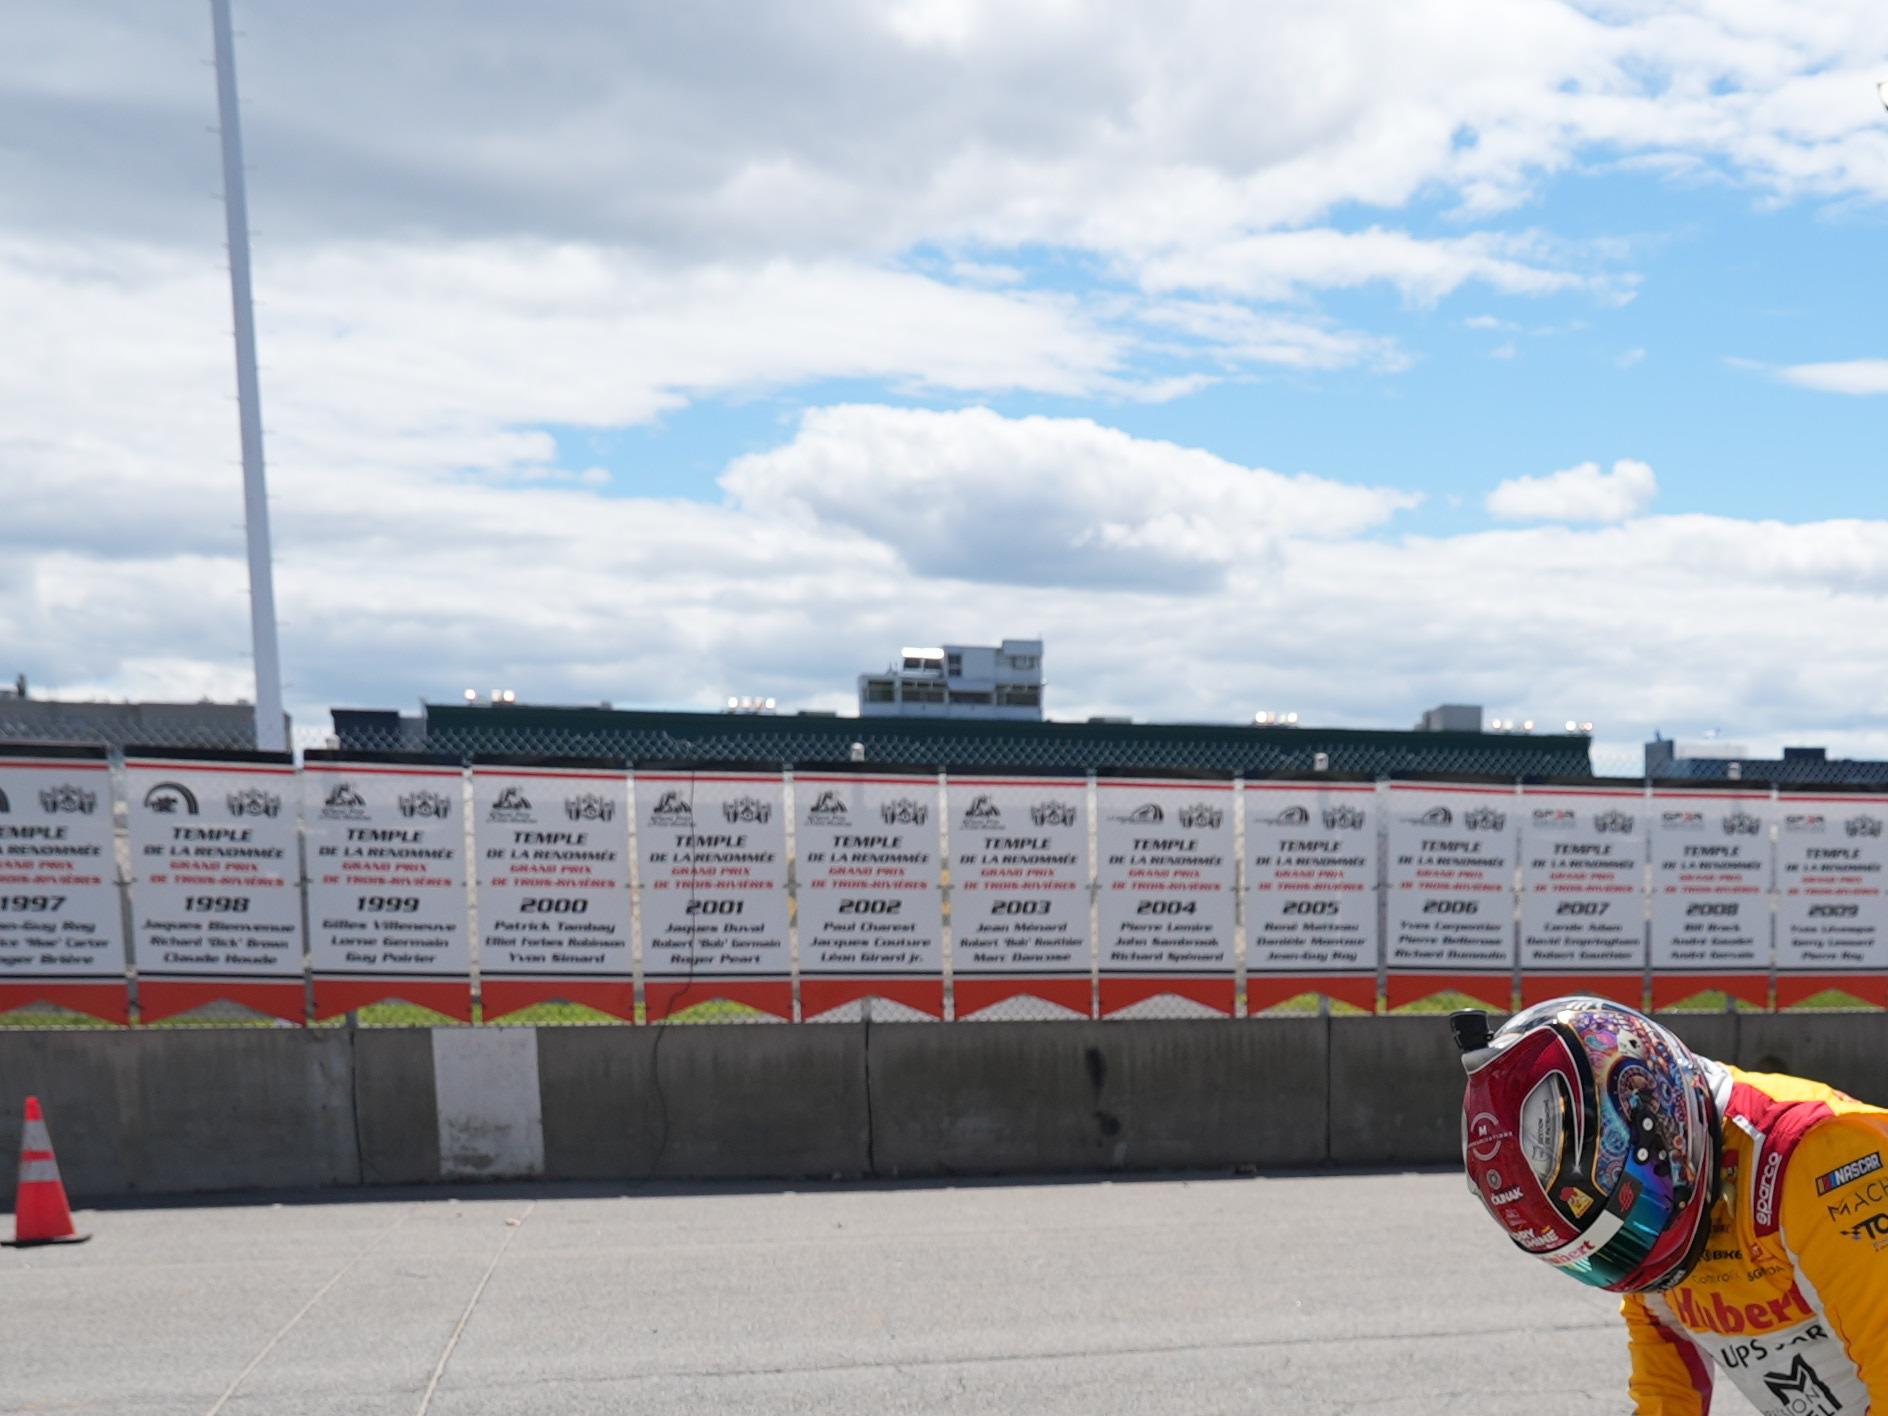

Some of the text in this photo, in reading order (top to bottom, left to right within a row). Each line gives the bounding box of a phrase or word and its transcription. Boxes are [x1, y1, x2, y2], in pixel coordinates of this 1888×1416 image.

[0, 827, 67, 840] EMPLE
[172, 827, 253, 841] TEMPLE
[347, 829, 424, 843] TEMPLE
[513, 832, 588, 845] TEMPLE
[675, 834, 747, 848] TEMPLE
[833, 835, 902, 848] TEMPLE
[984, 837, 1051, 850] TEMPLE
[1133, 839, 1198, 851] TEMPLE
[1279, 840, 1343, 852] TEMPLE
[1421, 841, 1482, 852] TEMPLE
[319, 846, 340, 857] DE
[344, 847, 363, 857] LA
[486, 849, 506, 859] DE
[511, 849, 529, 859] LA
[1553, 844, 1614, 855] TEMPLE
[1683, 845, 1739, 857] TEMPLE
[650, 853, 667, 863] DE
[673, 853, 690, 863] LA
[0, 896, 66, 912] 1997
[184, 897, 250, 913] 1998
[357, 896, 419, 912] 1999
[520, 898, 588, 914] 2000
[686, 899, 744, 915] 2001
[838, 899, 902, 915] 2002
[991, 900, 1052, 915] 2003
[1137, 900, 1197, 915] 2004
[1283, 901, 1340, 915] 2005
[1422, 901, 1479, 914] 2006
[1556, 902, 1610, 916] 2007
[1686, 903, 1739, 916] 2008
[1808, 905, 1859, 918] 2009
[374, 921, 456, 932] Villeneuve
[495, 921, 549, 932] Patrick
[1834, 1154, 1881, 1184] NASCAR
[1756, 1152, 1782, 1226] sparco
